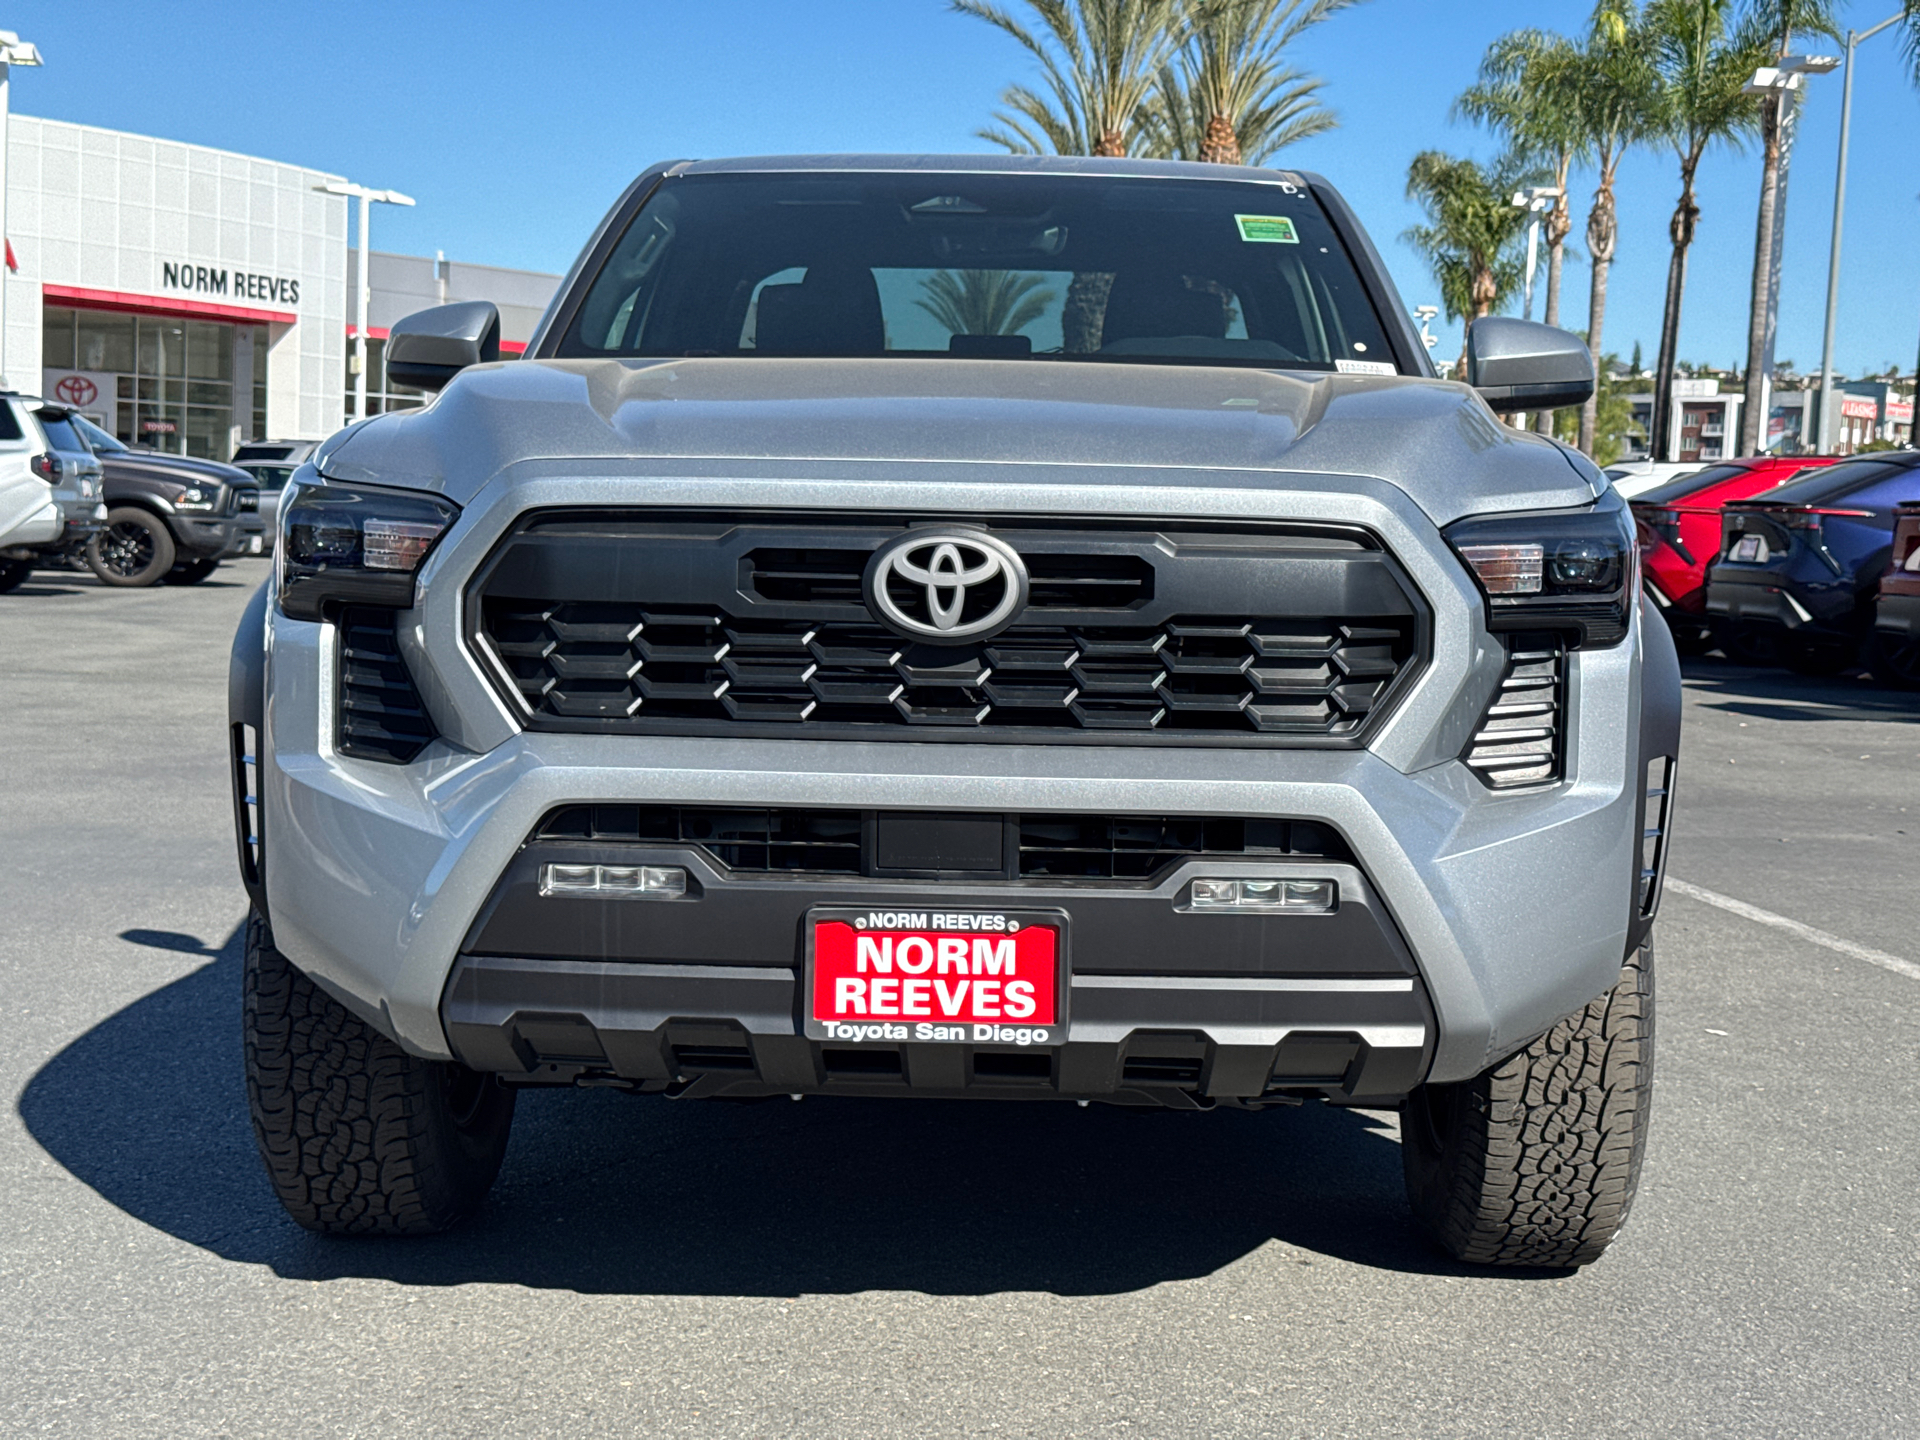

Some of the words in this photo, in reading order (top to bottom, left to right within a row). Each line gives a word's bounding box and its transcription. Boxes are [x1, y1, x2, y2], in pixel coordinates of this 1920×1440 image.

[163, 261, 228, 296] NORM
[234, 271, 300, 305] REEVES
[869, 912, 927, 929] NORM
[932, 914, 1006, 931] REEVES
[856, 936, 1016, 976] NORM
[834, 977, 1036, 1018] REEVES
[822, 1020, 908, 1043] Toyota
[915, 1022, 965, 1041] San
[973, 1023, 1049, 1046] Diego
